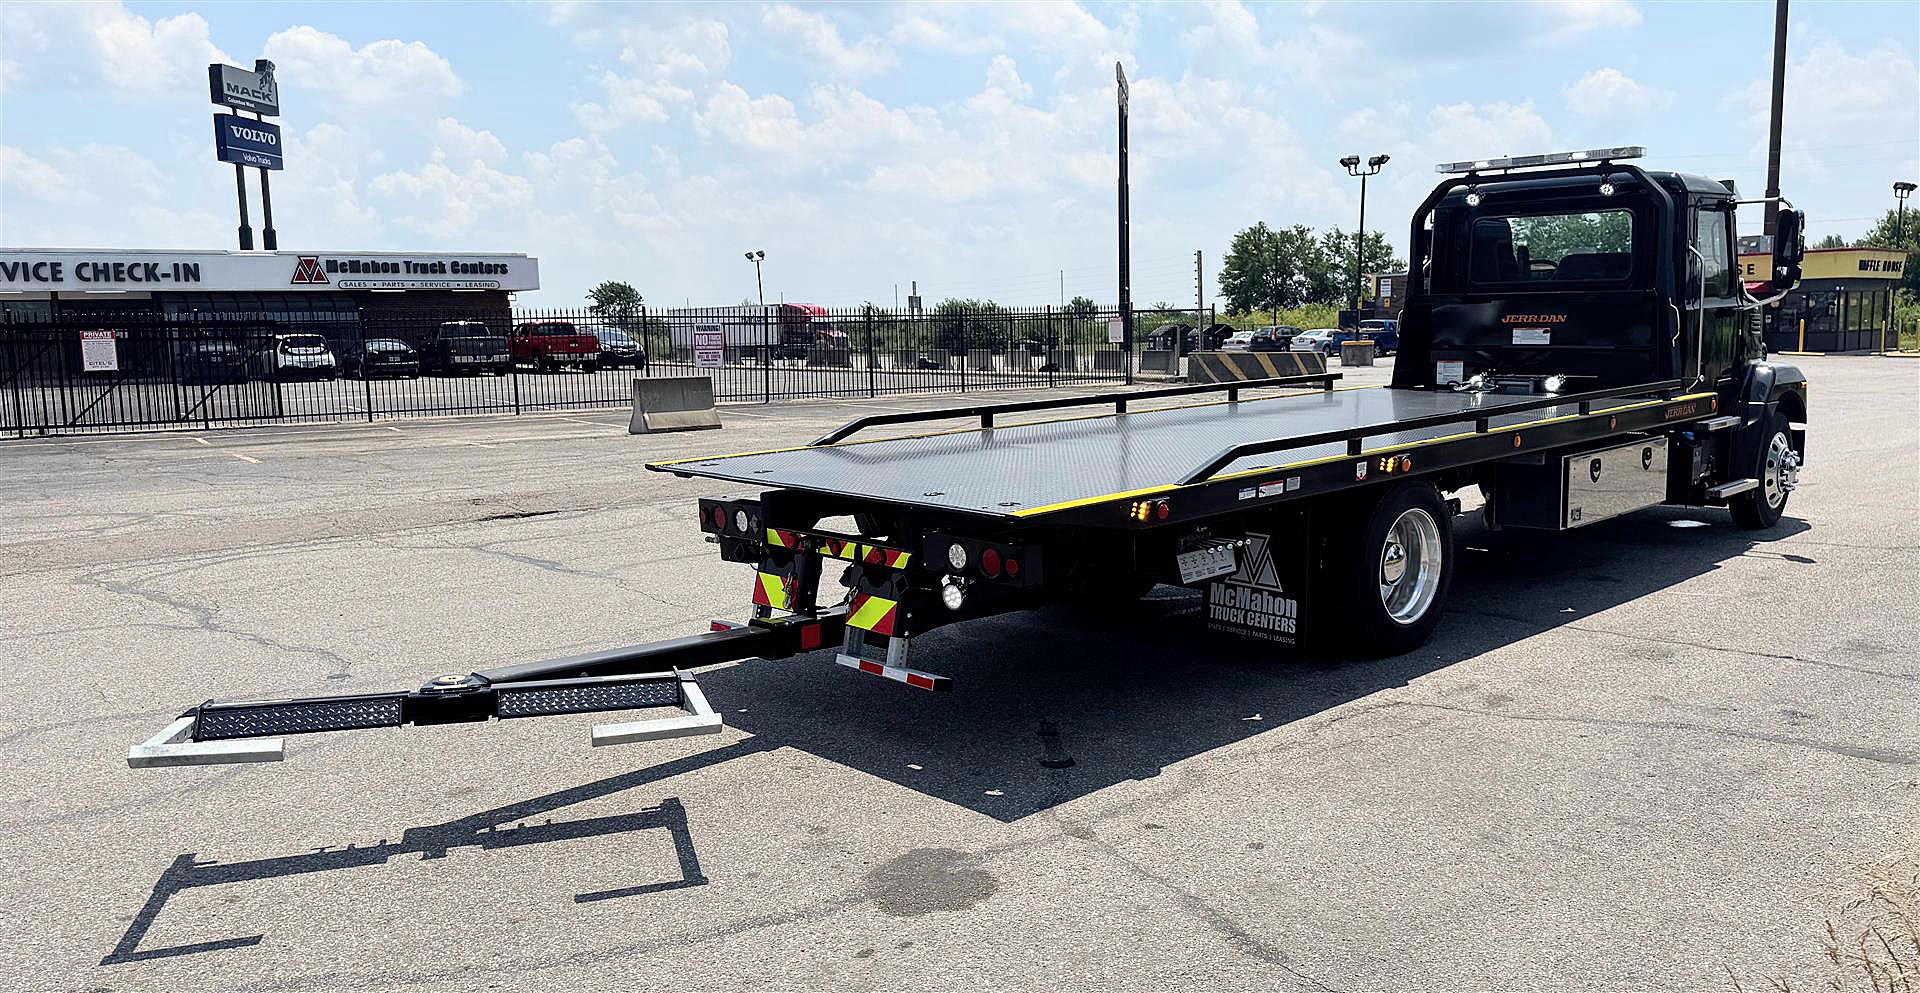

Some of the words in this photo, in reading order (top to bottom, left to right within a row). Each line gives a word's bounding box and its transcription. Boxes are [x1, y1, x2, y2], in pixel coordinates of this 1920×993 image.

[226, 82, 273, 102] MACK
[231, 125, 276, 145] VOLVO
[242, 152, 256, 162] Volvo
[75, 262, 201, 282] CHECK-IN
[326, 259, 400, 274] McMahon
[403, 260, 447, 275] Truck
[450, 260, 509, 275] Centers
[695, 334, 708, 346] NO
[1210, 582, 1297, 618] McMahon
[1209, 604, 1245, 624] TRUCK
[1247, 611, 1296, 634] CENTERS
